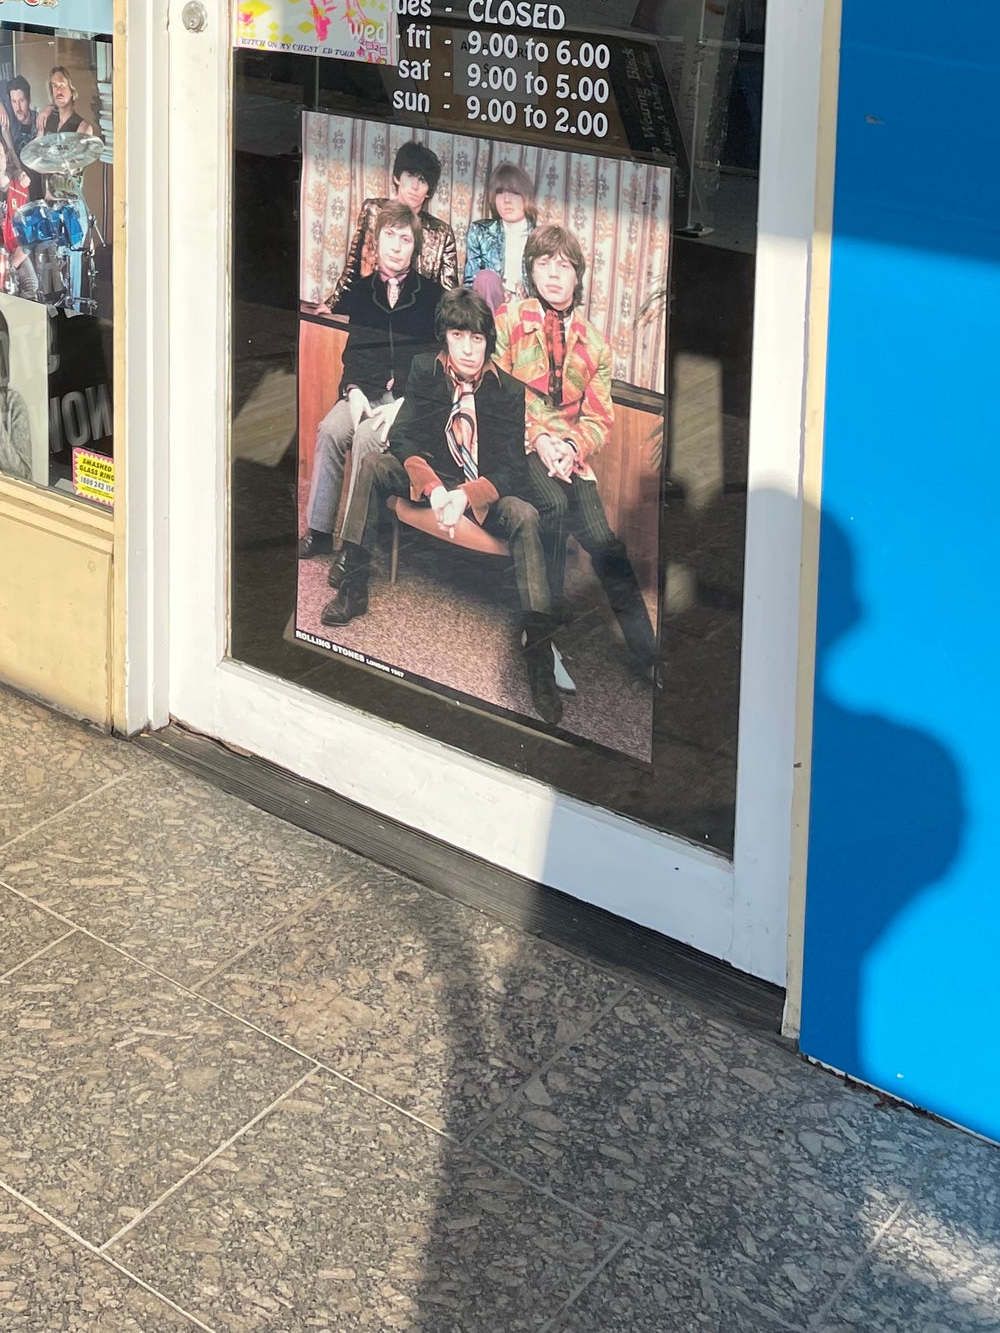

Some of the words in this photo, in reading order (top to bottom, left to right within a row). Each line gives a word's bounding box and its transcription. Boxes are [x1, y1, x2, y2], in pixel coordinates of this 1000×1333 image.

[350, 21, 388, 42] wed
[406, 23, 431, 49] fri
[467, 31, 518, 58] 9.00
[525, 37, 548, 63] to
[556, 40, 610, 70] 6.00
[398, 58, 431, 81] sat
[467, 63, 517, 91] 9.00
[525, 70, 548, 96] to
[555, 74, 609, 104] 5.00
[392, 90, 431, 113] sun
[466, 96, 517, 124] 9.00
[523, 103, 547, 129] to
[554, 107, 608, 138] 2.00
[79, 465, 98, 476] GLASS
[82, 457, 112, 472] SMASHED
[296, 630, 331, 650] ROLLING
[332, 644, 365, 663] STONES
